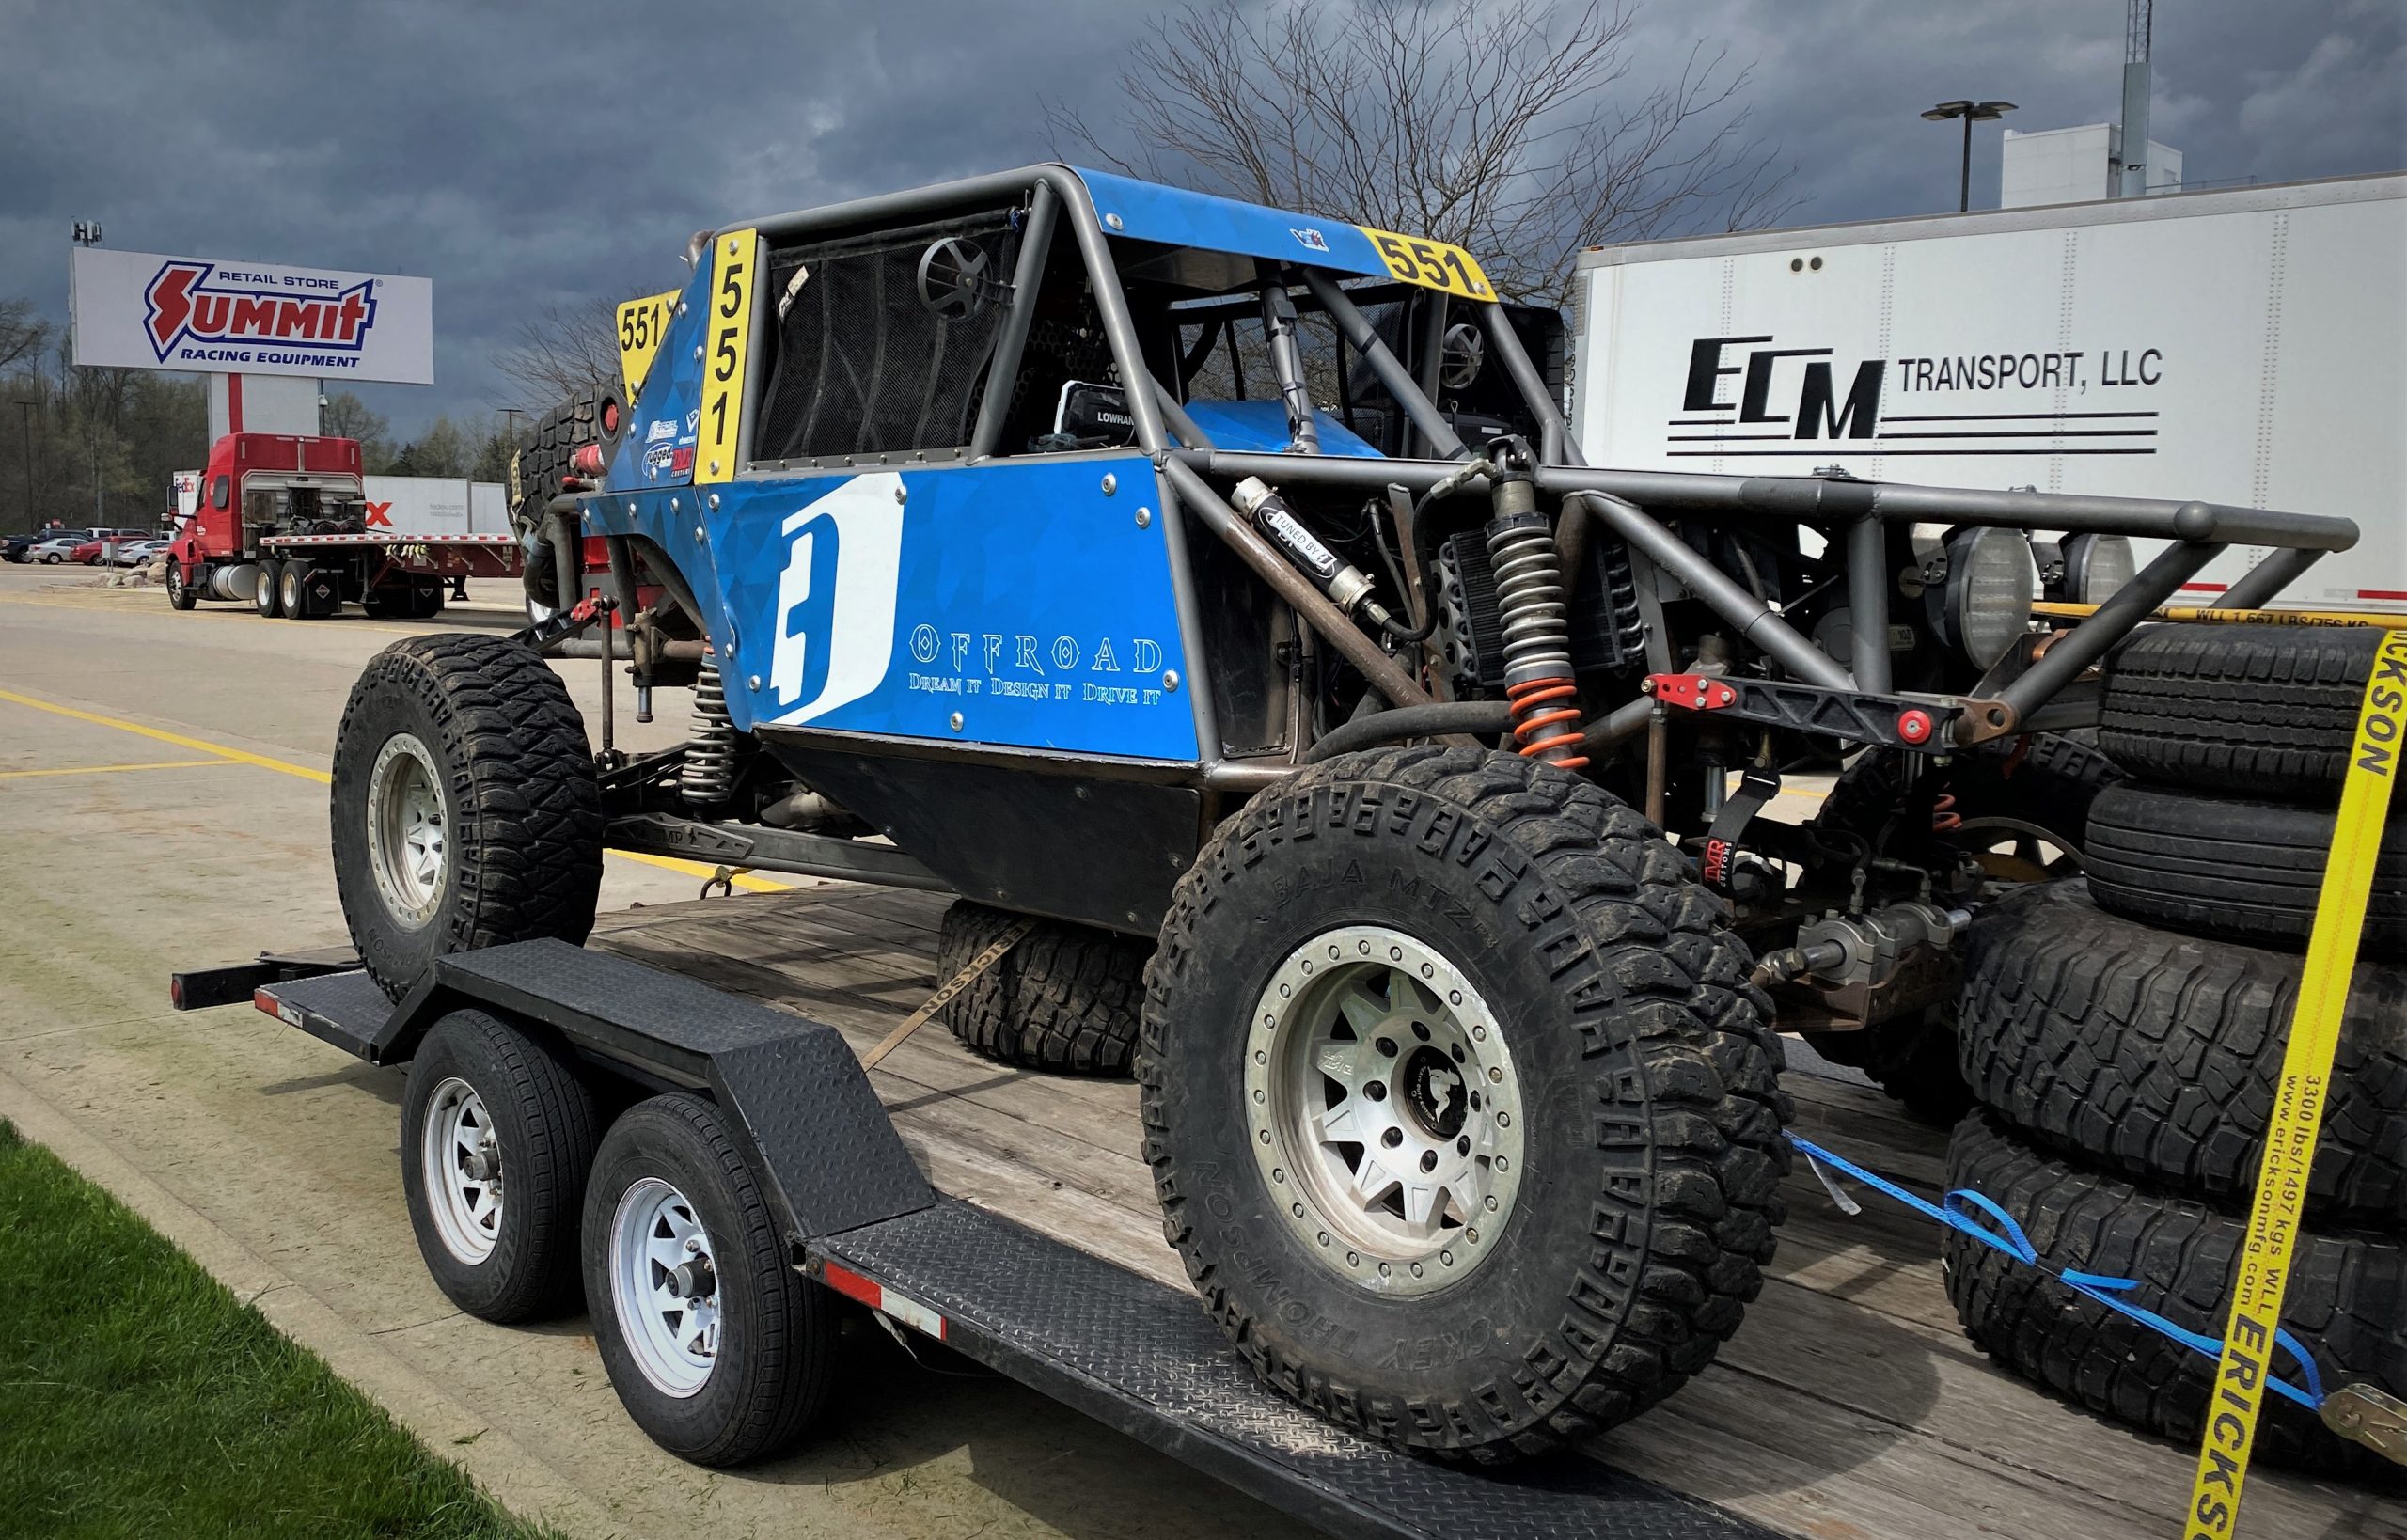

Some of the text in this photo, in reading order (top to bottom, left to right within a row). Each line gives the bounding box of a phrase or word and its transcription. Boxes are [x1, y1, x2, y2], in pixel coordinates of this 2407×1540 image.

[219, 271, 339, 289] RETAIL STORE
[1376, 235, 1477, 295] 551
[621, 303, 661, 352] 551
[181, 348, 361, 368] RACING EQUIPMENT
[1899, 348, 2163, 395] TRANSPORT, LLC
[1683, 335, 1887, 440] ECM
[1097, 411, 1135, 426] LOWRAN
[1275, 514, 1307, 544] TUNED
[1305, 542, 1321, 556] BY
[909, 623, 1162, 676] OFFROAD
[1272, 857, 1364, 909] BAJA
[1389, 866, 1474, 927] MTZ
[921, 926, 1025, 1015] ERICKSON
[2298, 1076, 2321, 1121] 3300
[2241, 1076, 2297, 1305] www.ericksonmfg.com
[2280, 1127, 2311, 1215] lbs/1497
[2270, 1219, 2291, 1256] kgs
[2192, 1313, 2268, 1540] ERICKS
